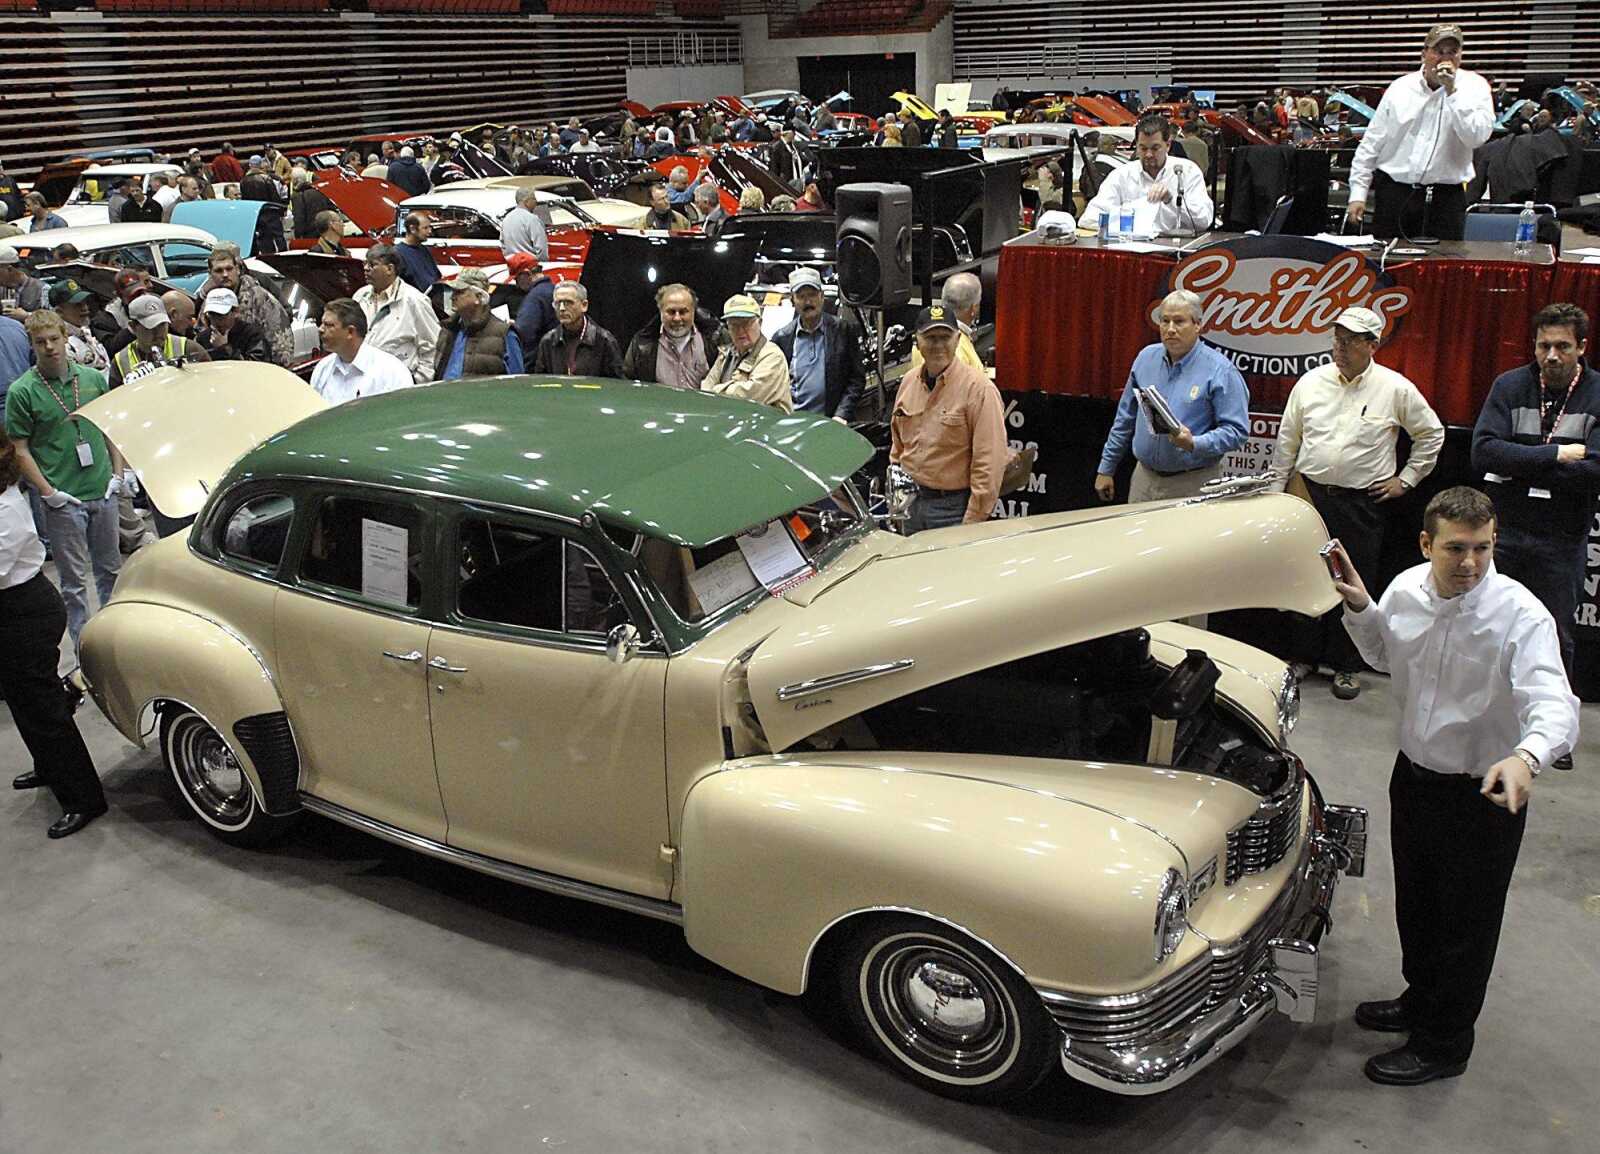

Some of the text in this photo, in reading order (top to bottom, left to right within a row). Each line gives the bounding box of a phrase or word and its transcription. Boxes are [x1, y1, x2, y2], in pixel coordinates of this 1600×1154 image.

[1149, 250, 1410, 337] Smith's
[1215, 346, 1299, 375] UCTION
[1227, 456, 1256, 470] THIS
